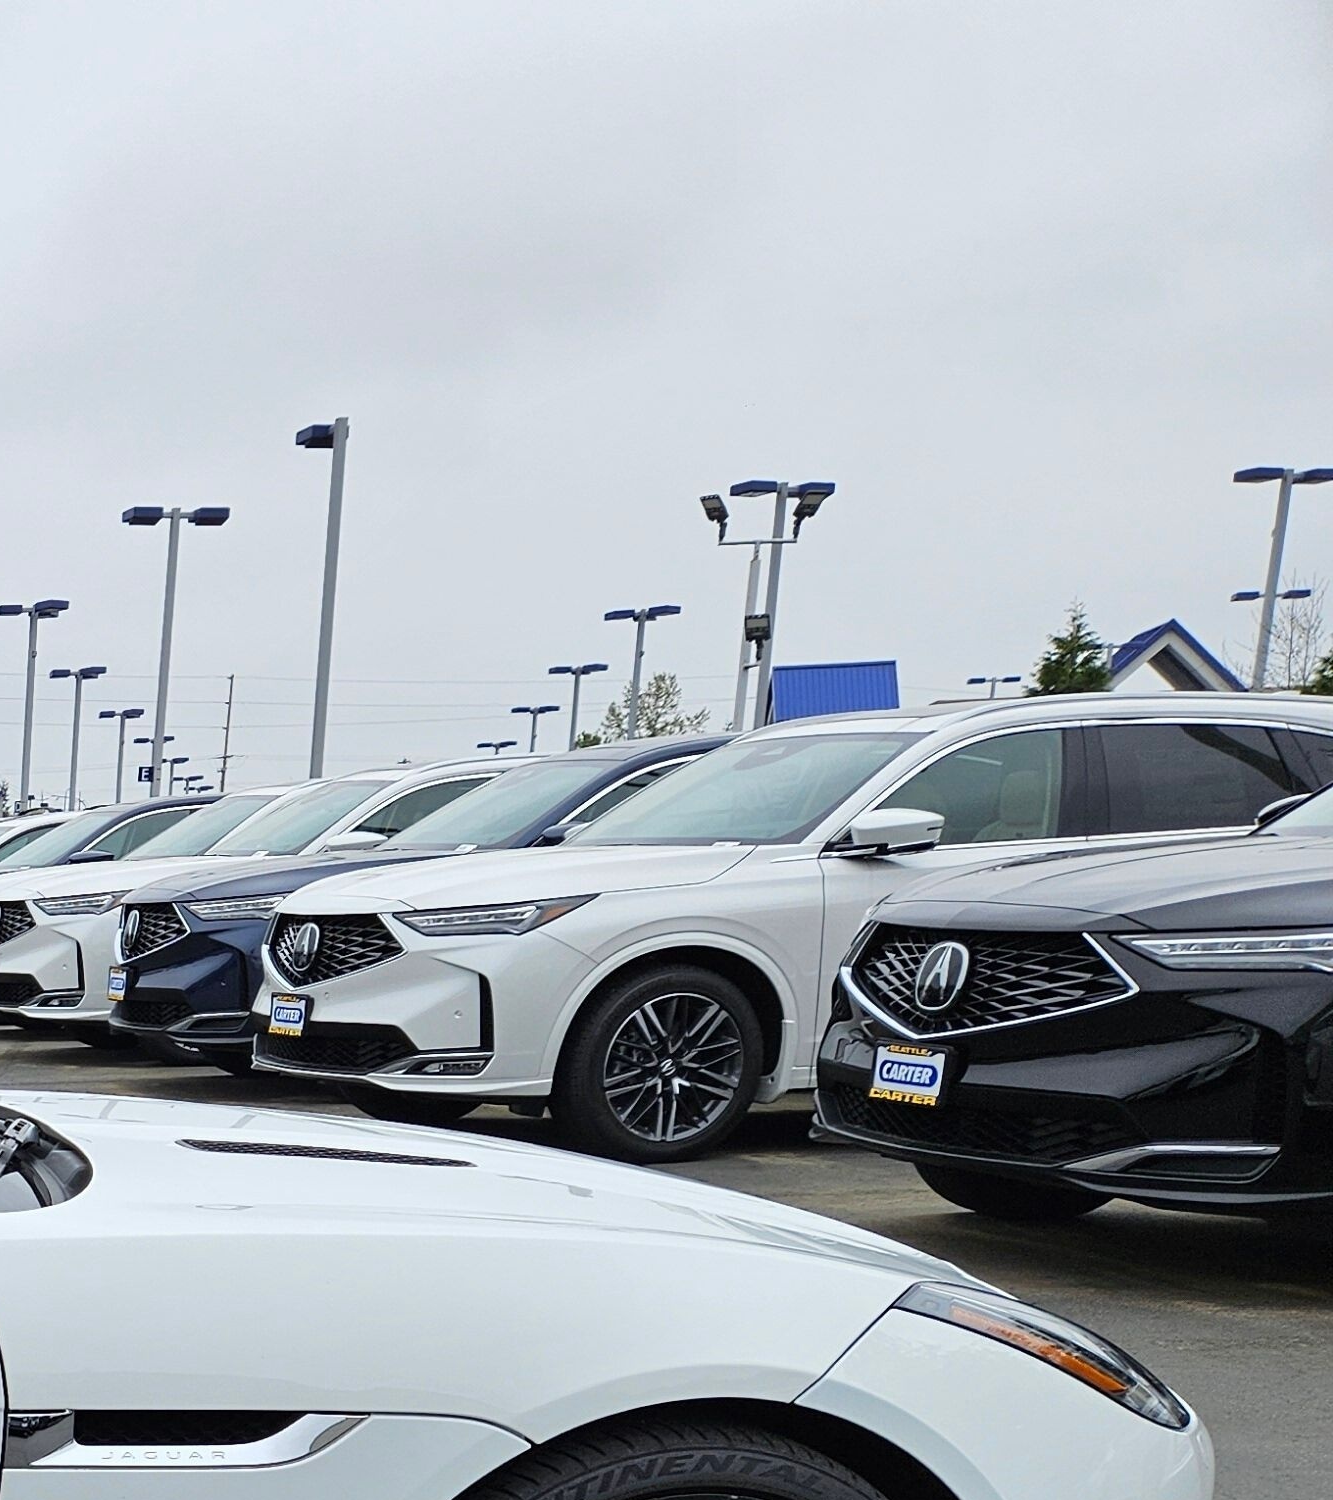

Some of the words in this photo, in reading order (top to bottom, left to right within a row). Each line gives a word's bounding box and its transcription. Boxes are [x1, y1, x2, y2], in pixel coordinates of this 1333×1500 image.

[141, 768, 149, 781] E
[889, 1044, 929, 1056] SEATTLE
[881, 1062, 933, 1085] CARTER
[869, 1087, 937, 1106] CARTER
[101, 1451, 225, 1460] JAGUAR
